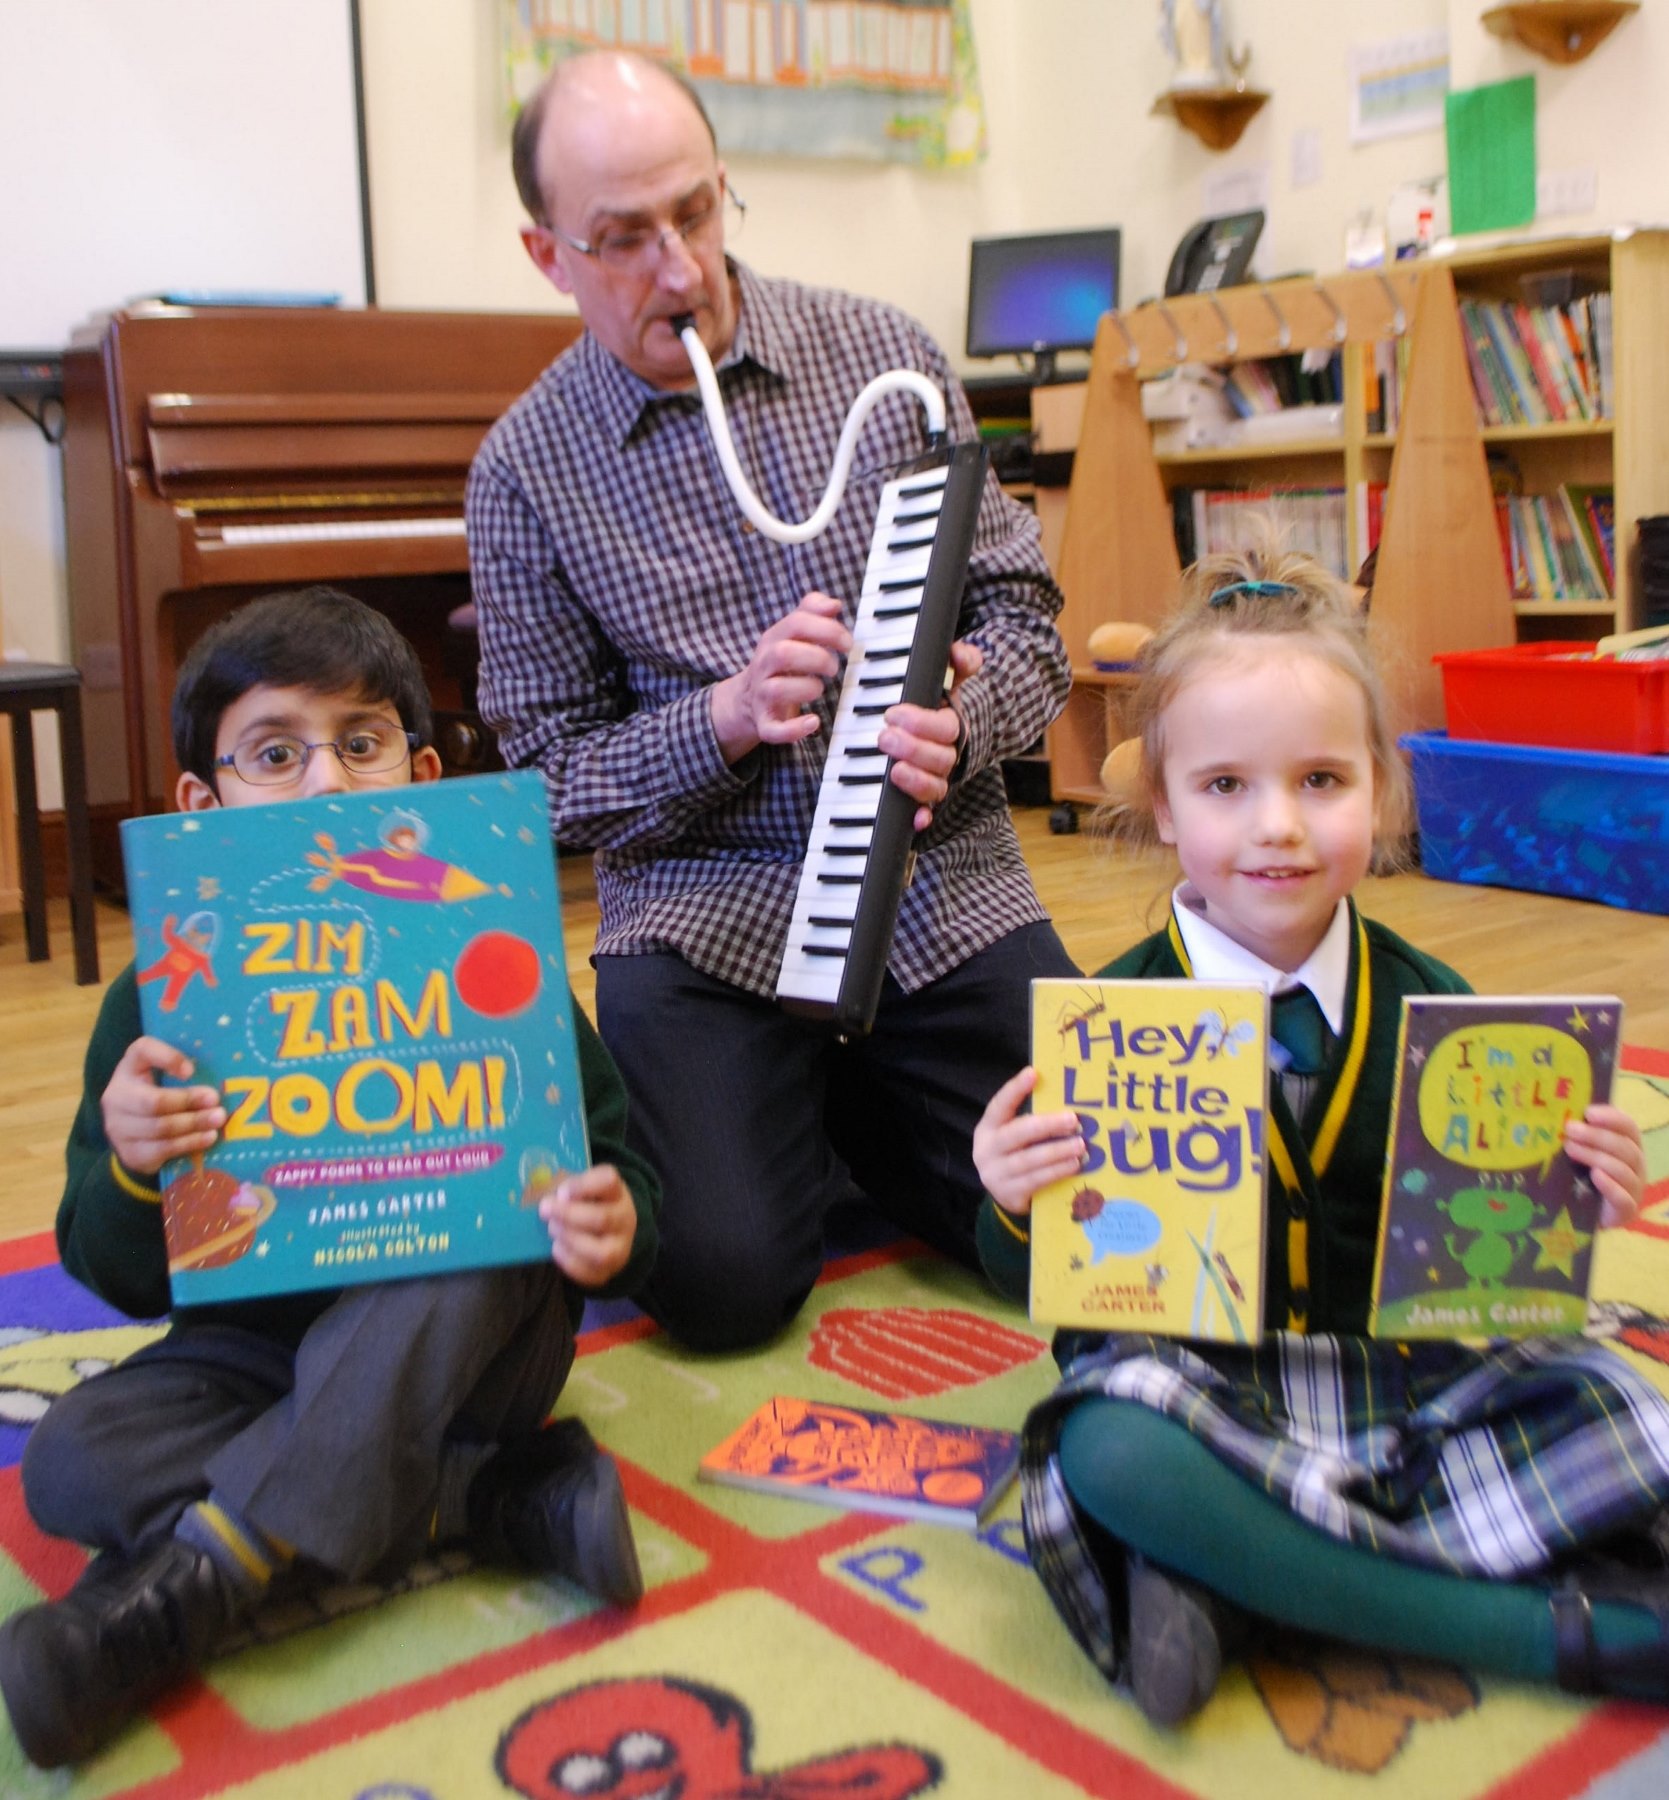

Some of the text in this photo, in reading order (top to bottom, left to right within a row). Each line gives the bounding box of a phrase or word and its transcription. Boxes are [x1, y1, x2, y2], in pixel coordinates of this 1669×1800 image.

[243, 919, 366, 974] ZIM
[270, 969, 453, 1059] ZAM
[1075, 1018, 1217, 1066] Hey,
[1456, 1036, 1515, 1070] I'm
[222, 1056, 507, 1141] ZOOM!
[1063, 1062, 1229, 1117] Little
[274, 1165, 316, 1186] ZAPPY
[319, 1161, 364, 1179] POEMS
[367, 1160, 385, 1175] TO
[387, 1157, 422, 1174] READ
[425, 1152, 451, 1170] OUT
[307, 1188, 447, 1227] JAMES CARTER
[313, 1241, 379, 1267] NICOLA
[1406, 1302, 1482, 1327] James
